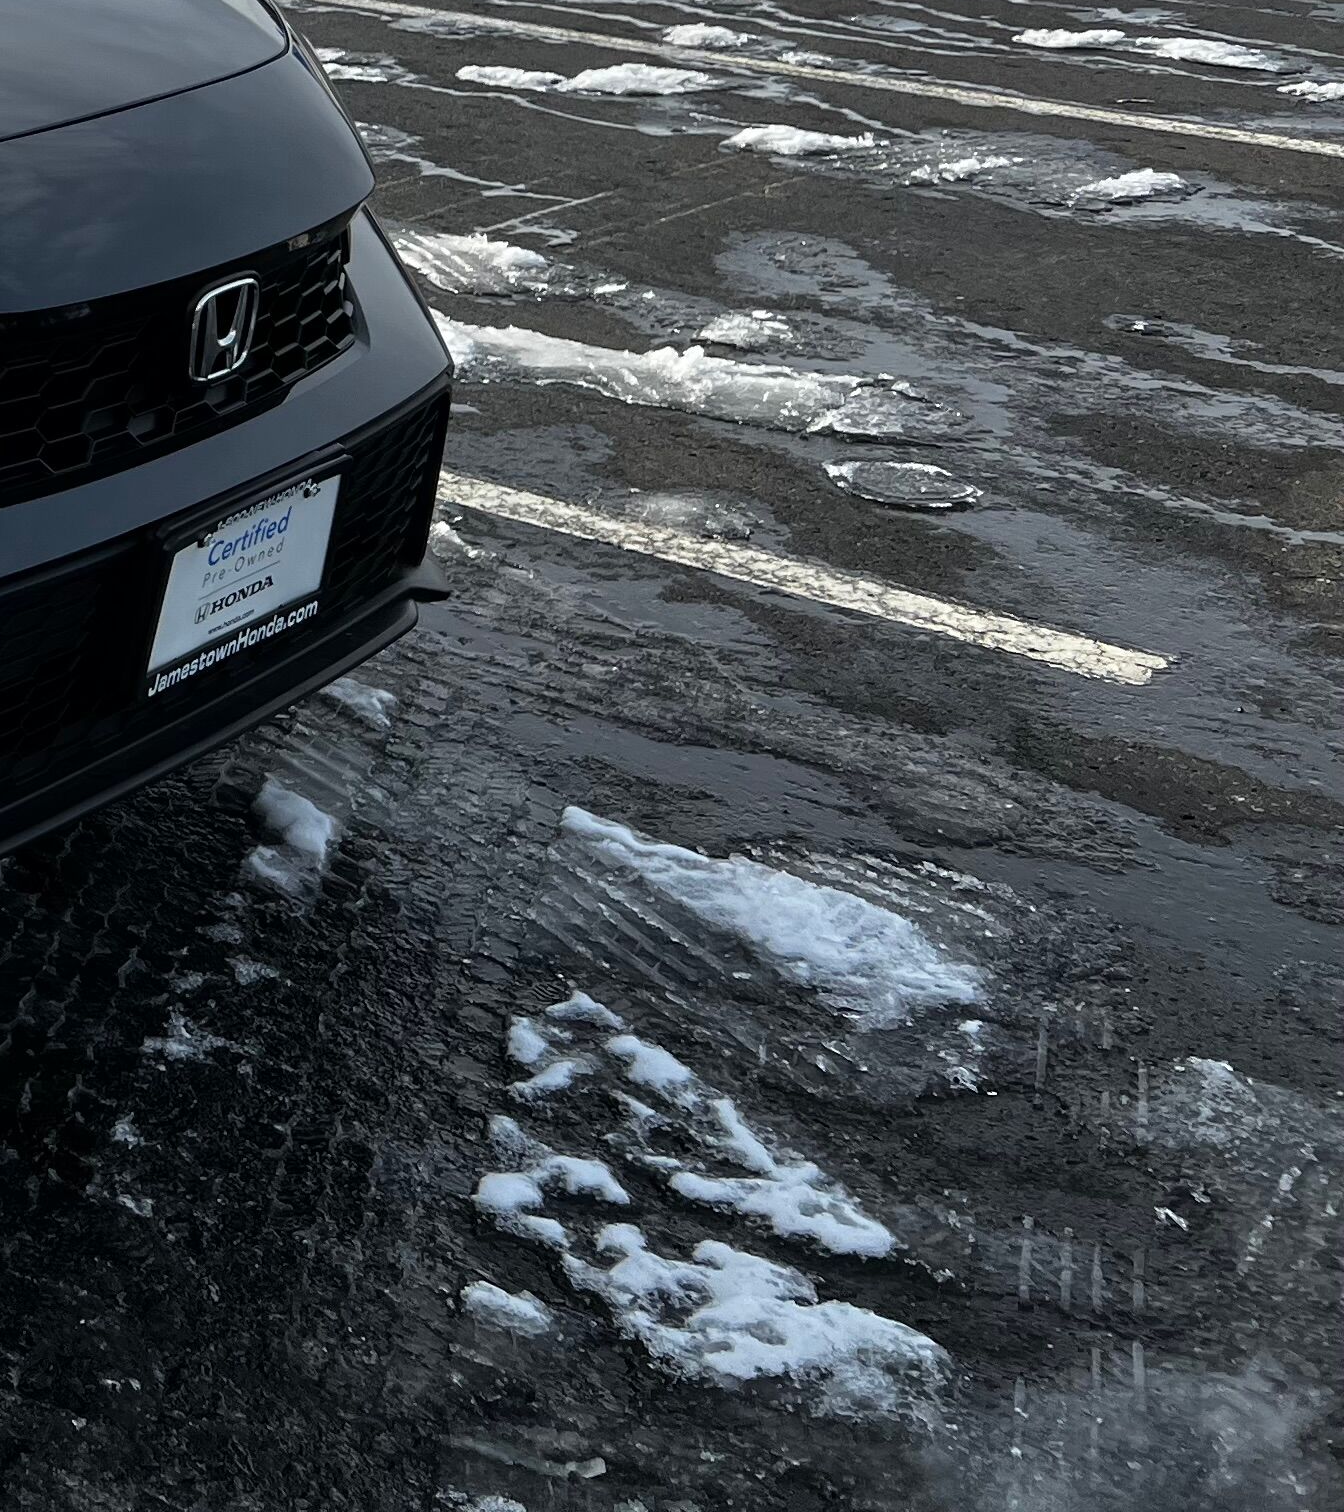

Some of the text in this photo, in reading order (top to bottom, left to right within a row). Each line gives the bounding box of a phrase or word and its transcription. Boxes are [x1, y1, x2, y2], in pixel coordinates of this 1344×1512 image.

[208, 505, 293, 567] Certified
[201, 540, 285, 588] Pre-Owned
[210, 574, 274, 616] HONDA
[147, 599, 319, 698] JamestownHonda.com
